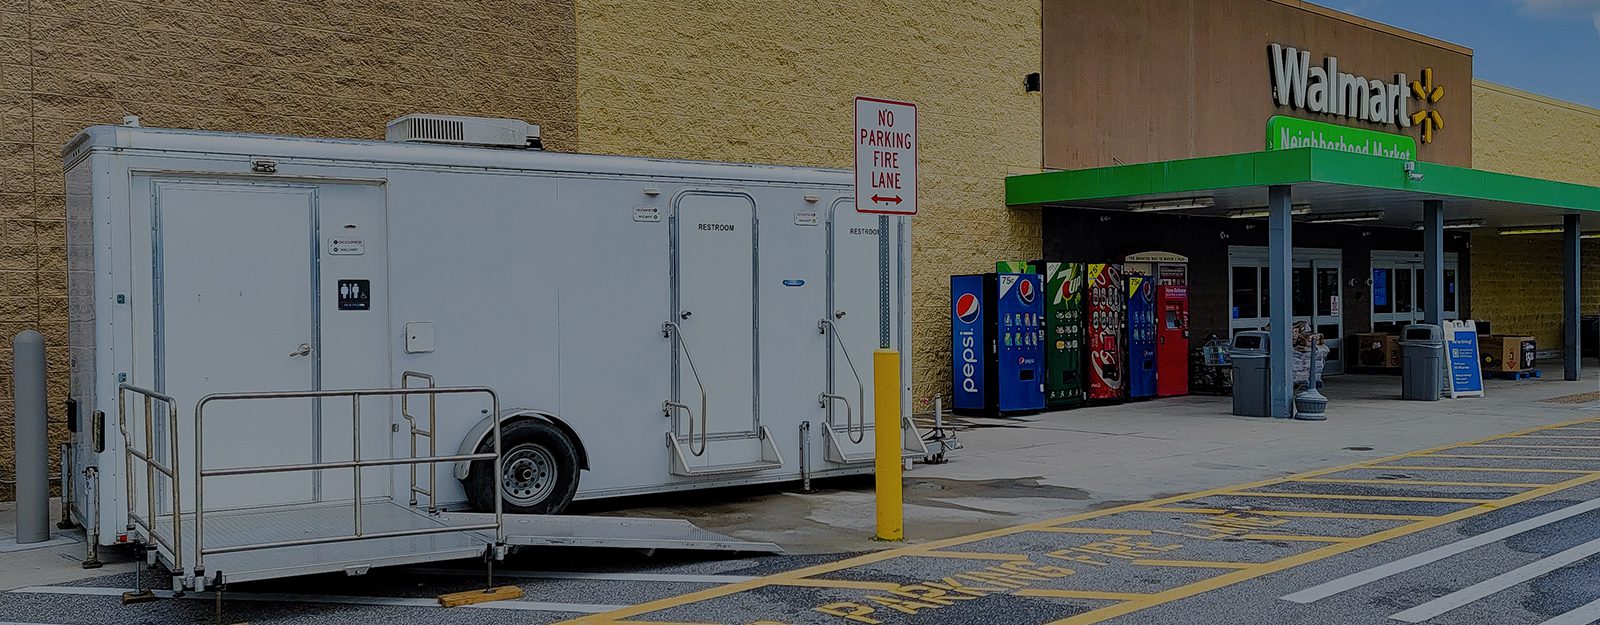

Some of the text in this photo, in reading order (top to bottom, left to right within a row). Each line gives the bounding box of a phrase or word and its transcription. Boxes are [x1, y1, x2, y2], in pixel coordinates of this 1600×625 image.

[1267, 43, 1411, 128] Walmart
[878, 109, 894, 127] NO
[860, 128, 911, 149] PARKING
[1280, 126, 1411, 160] Neighborhood Market
[873, 150, 899, 169] FIRE
[871, 171, 901, 189] LANE
[698, 223, 735, 231] RESTROOM
[960, 328, 978, 393] pepsi
[813, 561, 1077, 625] PARKING
